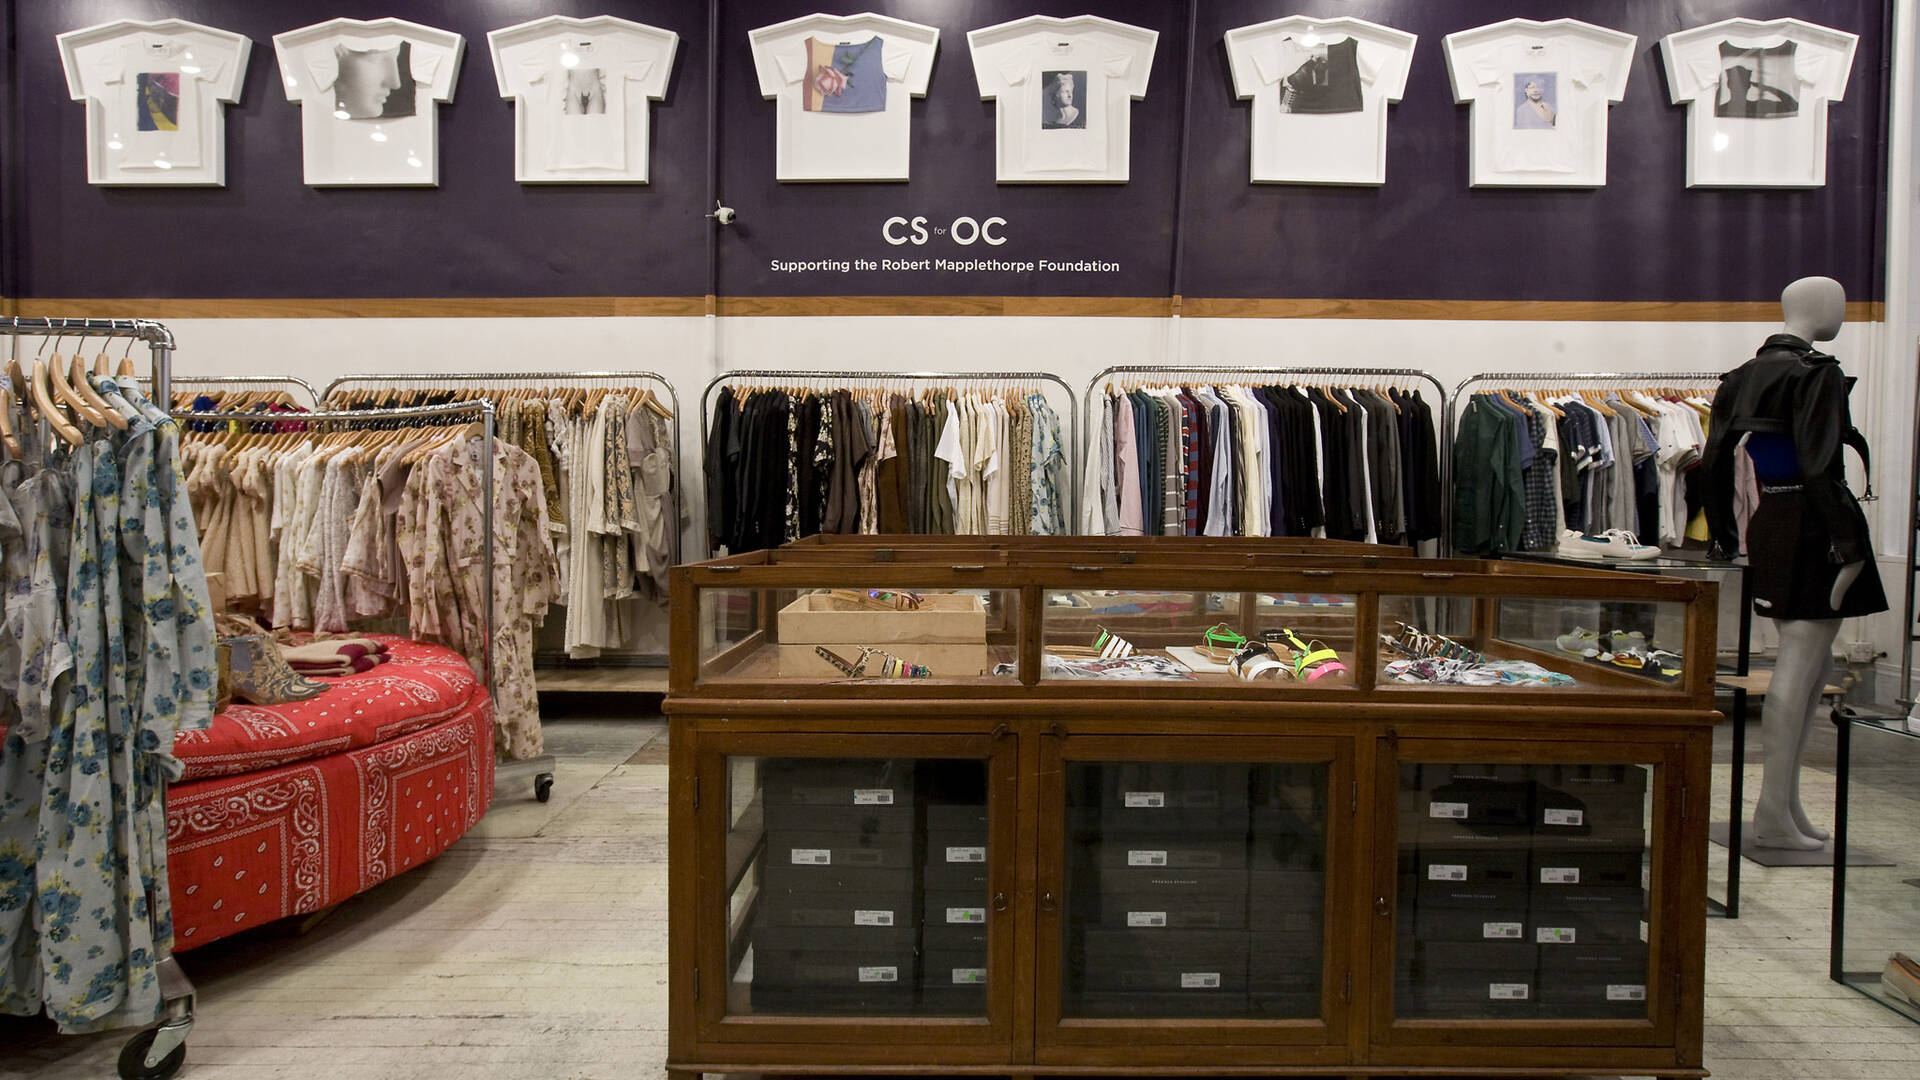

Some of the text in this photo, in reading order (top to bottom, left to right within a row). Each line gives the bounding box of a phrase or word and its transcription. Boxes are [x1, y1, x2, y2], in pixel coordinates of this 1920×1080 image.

[883, 216, 1008, 246] CS for OC
[770, 258, 1120, 274] Supporting the Robert Mapplethorpe Foundation
